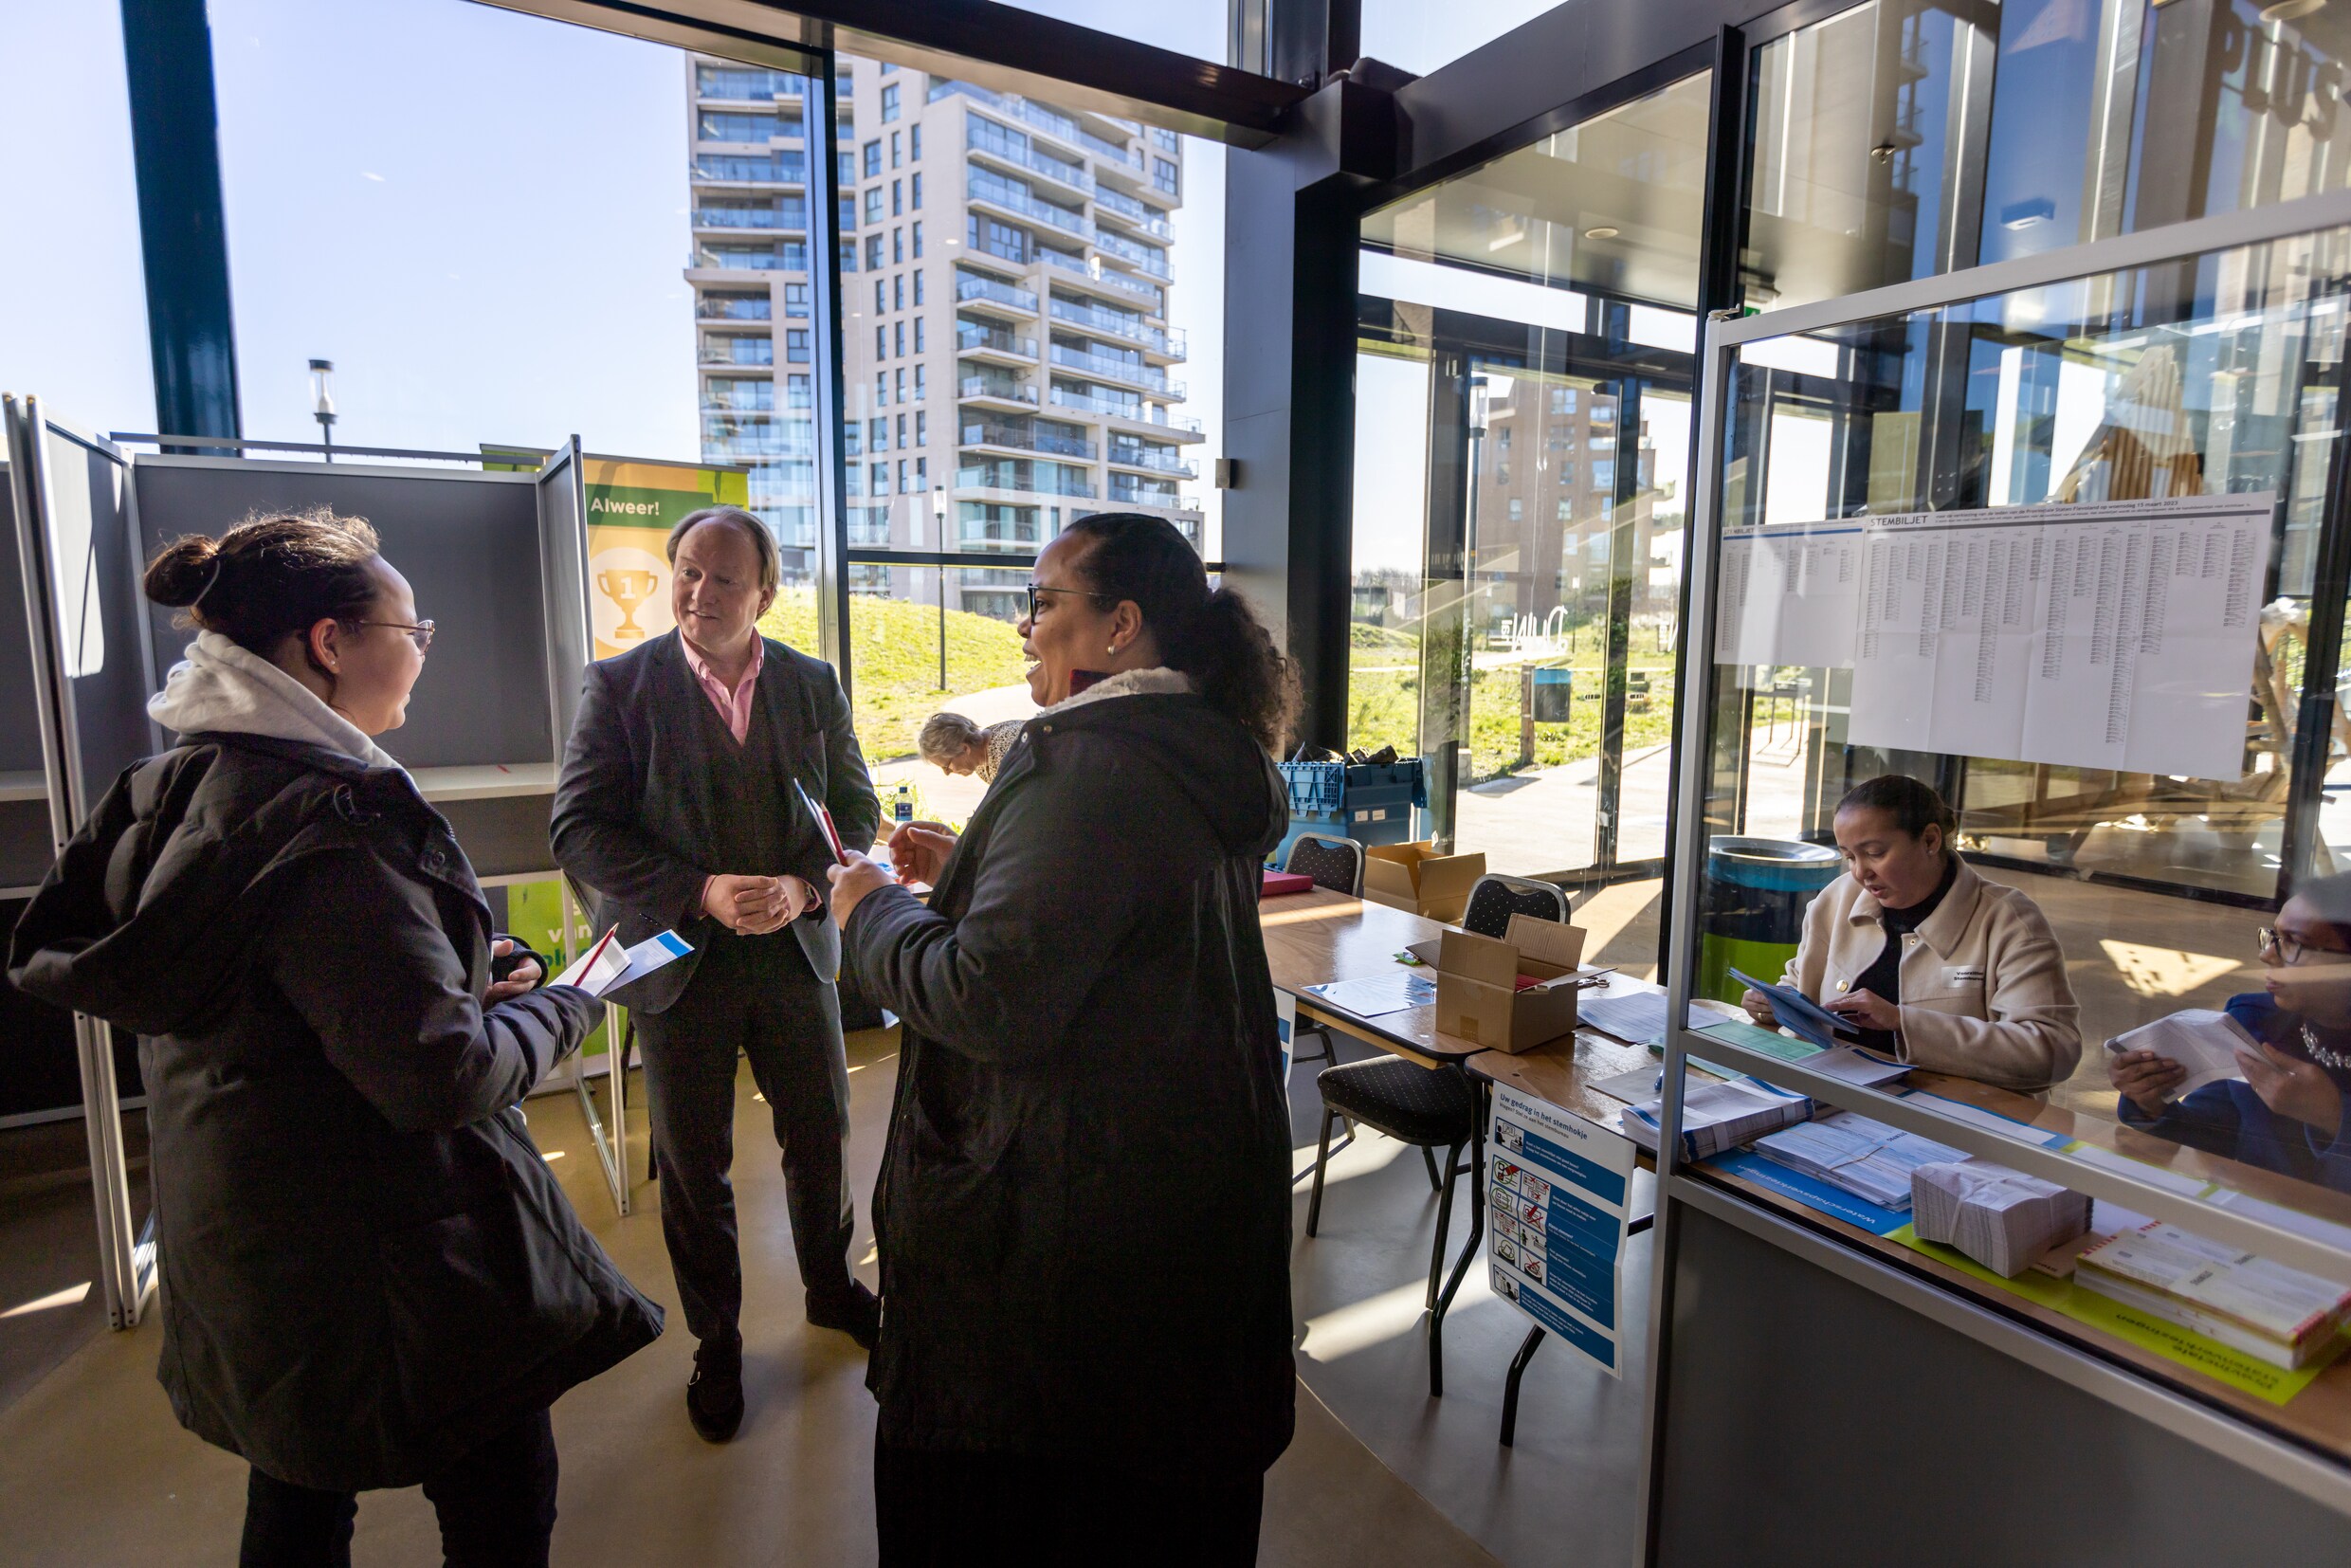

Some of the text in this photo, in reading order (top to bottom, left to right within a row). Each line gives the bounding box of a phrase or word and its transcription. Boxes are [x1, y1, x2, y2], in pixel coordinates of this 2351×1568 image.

[2212, 8, 2342, 142] PLUS
[591, 497, 659, 516] Alweer!
[1870, 515, 1928, 526] STEMBILJET
[620, 576, 636, 599] 1
[548, 924, 592, 943] vn
[1500, 1093, 1588, 1140] Uw gedrag in het stemhokje
[1737, 1164, 1876, 1224] Waterschapsverkiezingen
